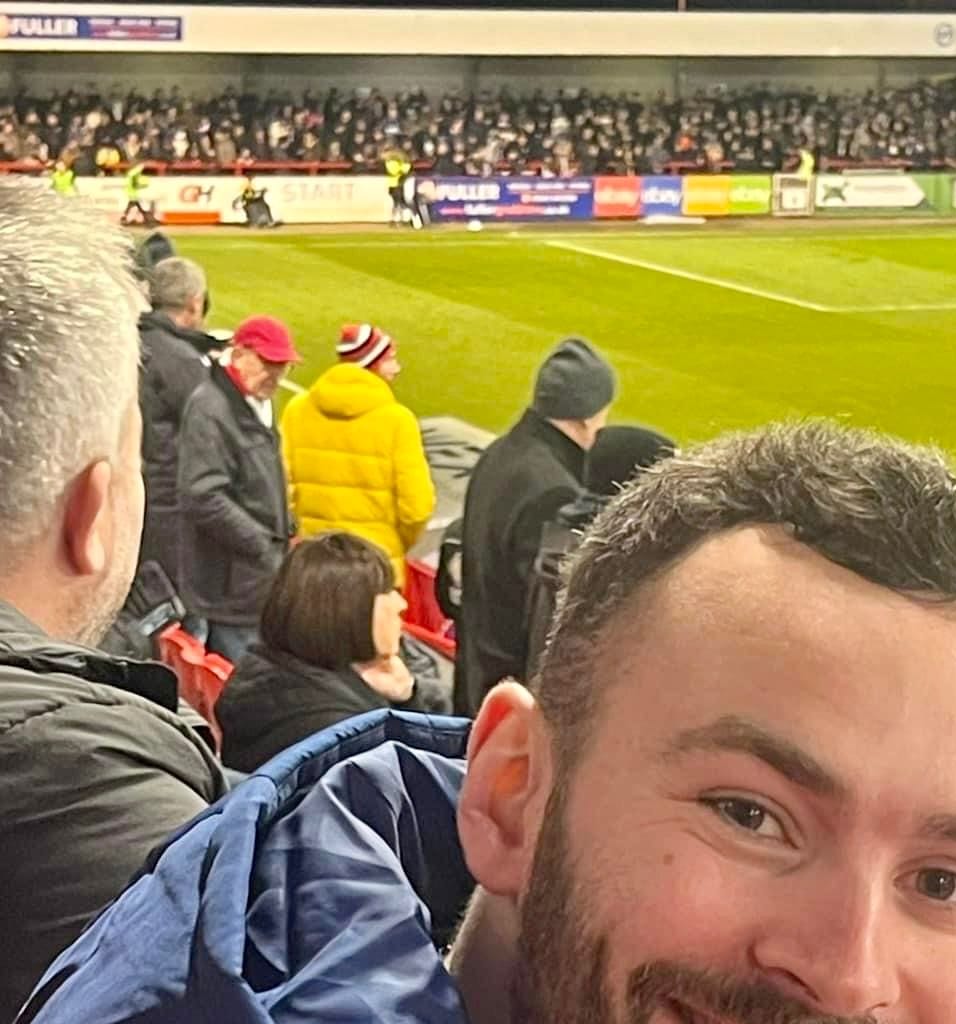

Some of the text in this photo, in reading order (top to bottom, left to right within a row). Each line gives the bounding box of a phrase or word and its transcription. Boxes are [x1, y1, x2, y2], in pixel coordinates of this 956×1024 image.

[10, 17, 79, 36] FULLER
[281, 183, 355, 202] START
[436, 182, 500, 201] FULLER
